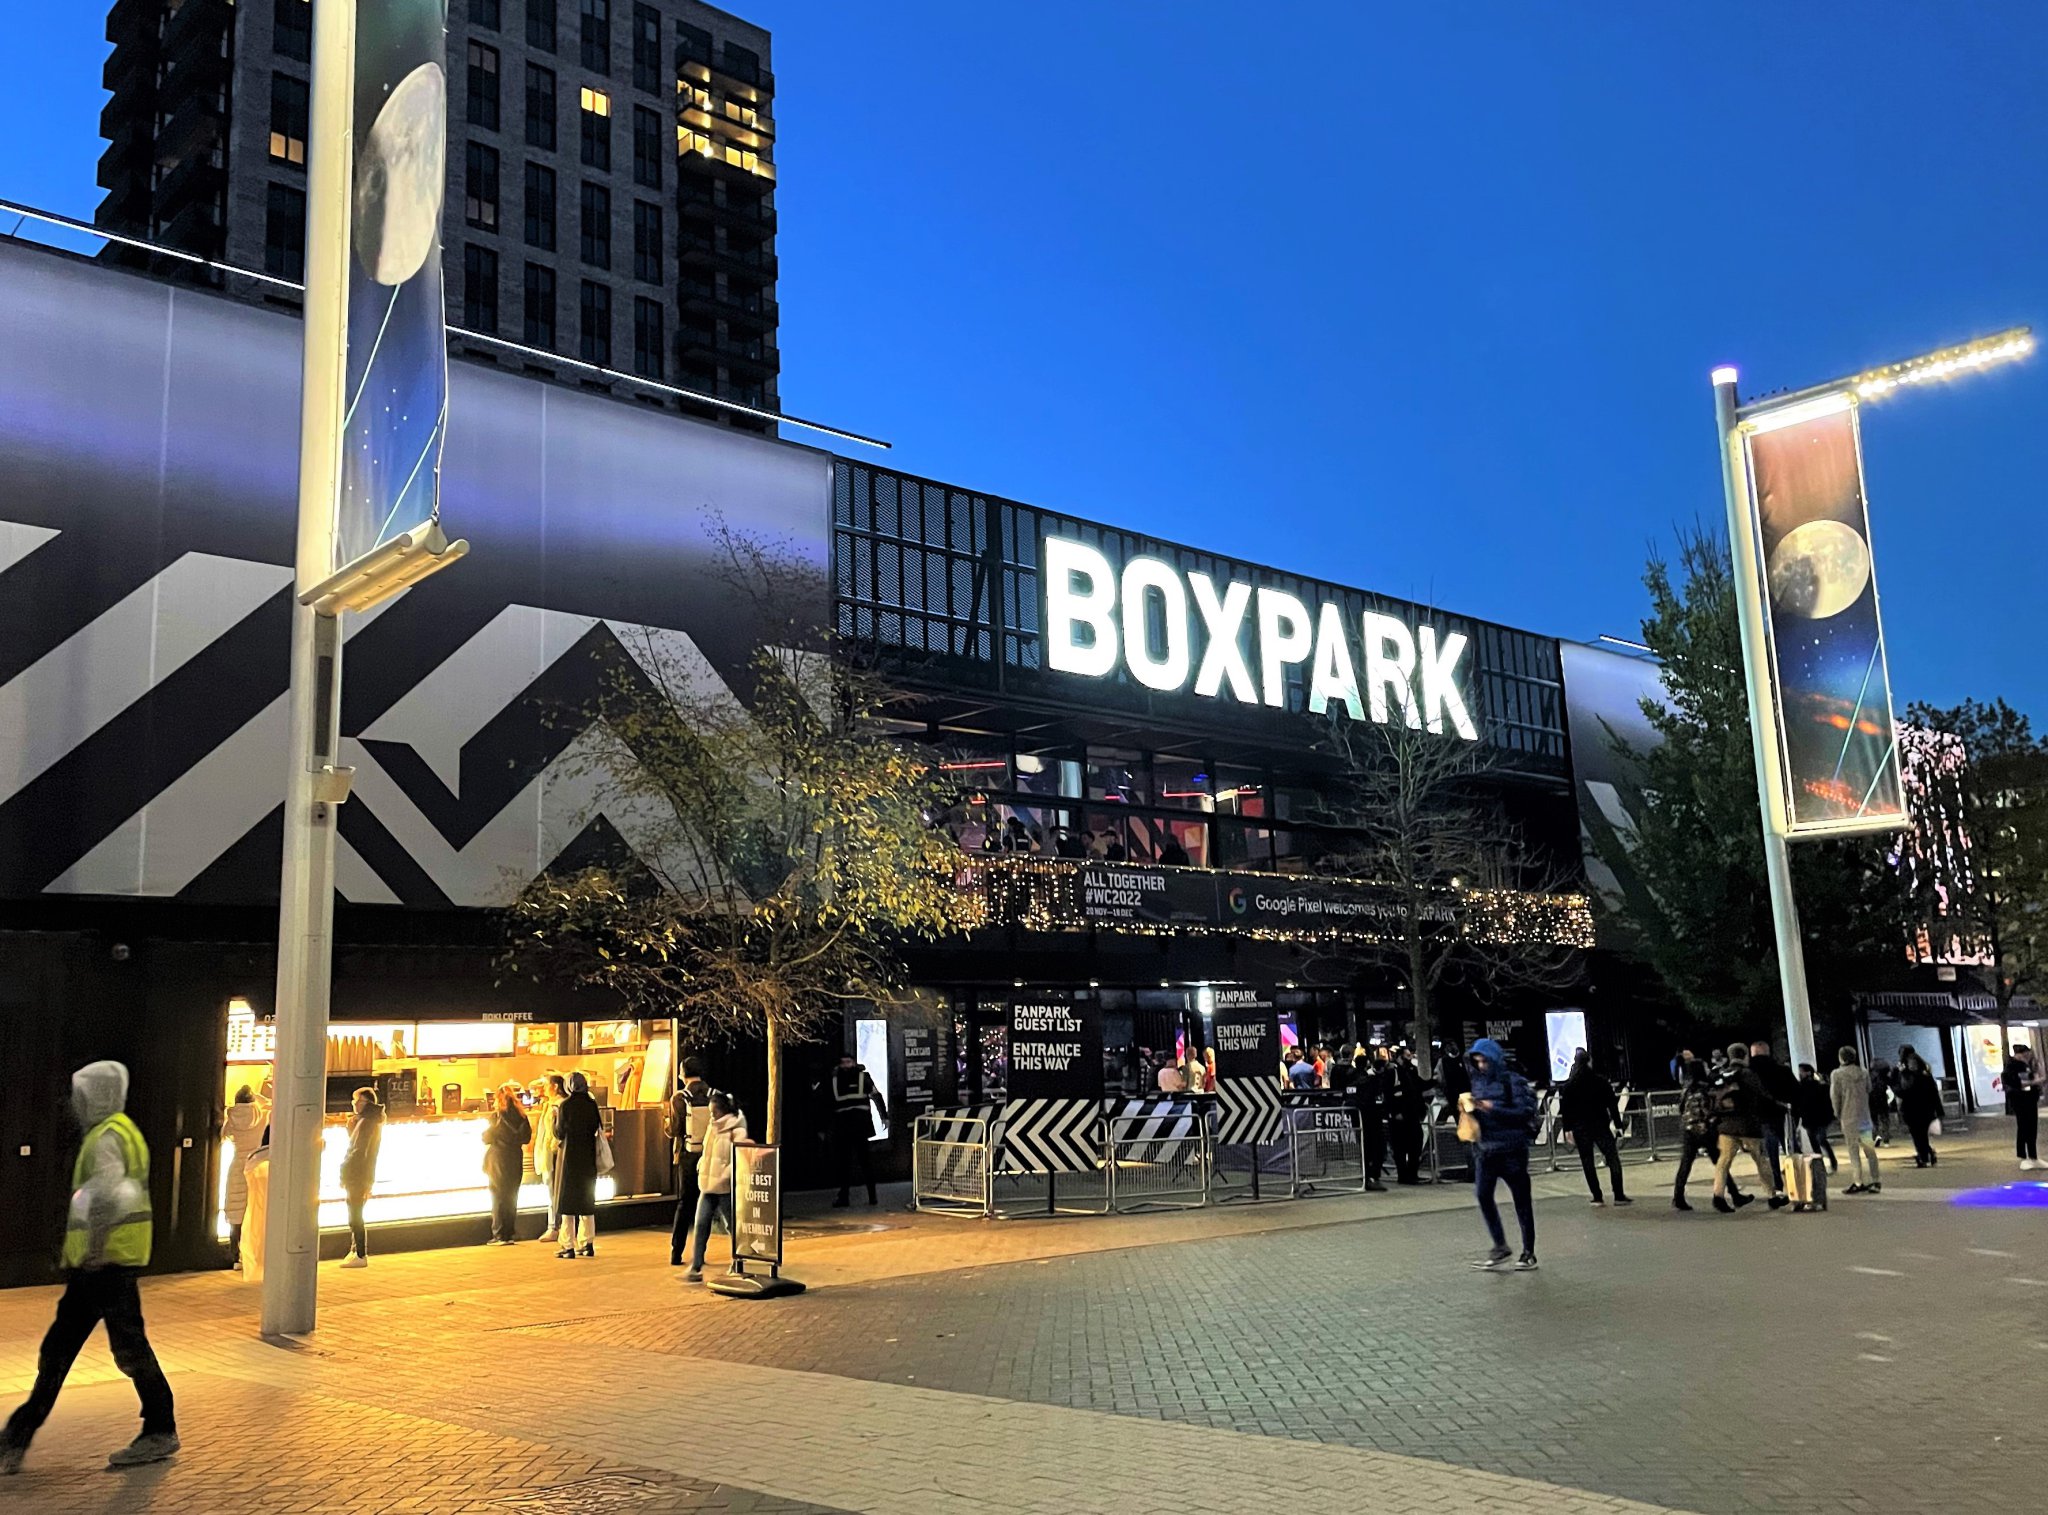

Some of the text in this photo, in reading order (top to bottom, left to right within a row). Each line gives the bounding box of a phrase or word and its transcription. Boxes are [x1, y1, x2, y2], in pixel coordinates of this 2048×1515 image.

[1045, 537, 1478, 741] BOXPARK
[1083, 872, 1166, 891] ALL TOGETHER
[1085, 888, 1142, 906] #WC2022
[1086, 906, 1094, 915] 20
[1121, 908, 1134, 918] DEC
[1255, 894, 1297, 915] Google
[1298, 897, 1322, 913] Pixel
[1324, 901, 1376, 917] welcomes
[1214, 990, 1257, 1003] FANPARK
[503, 1012, 533, 1021] COFFEE
[1014, 1005, 1071, 1019] FANPARK
[1014, 1018, 1083, 1032] GUEST LIST
[1217, 1024, 1267, 1038] ENTRANCE
[1013, 1042, 1082, 1057] ENTRANCE
[1218, 1037, 1260, 1051] THIS WAY
[1013, 1057, 1071, 1071] THIS WAY
[391, 1080, 410, 1092] ICE
[743, 1174, 772, 1186] THE BEST
[745, 1191, 769, 1203] COFFEE
[752, 1207, 761, 1218] IN
[742, 1222, 773, 1236] WEMBLEY
